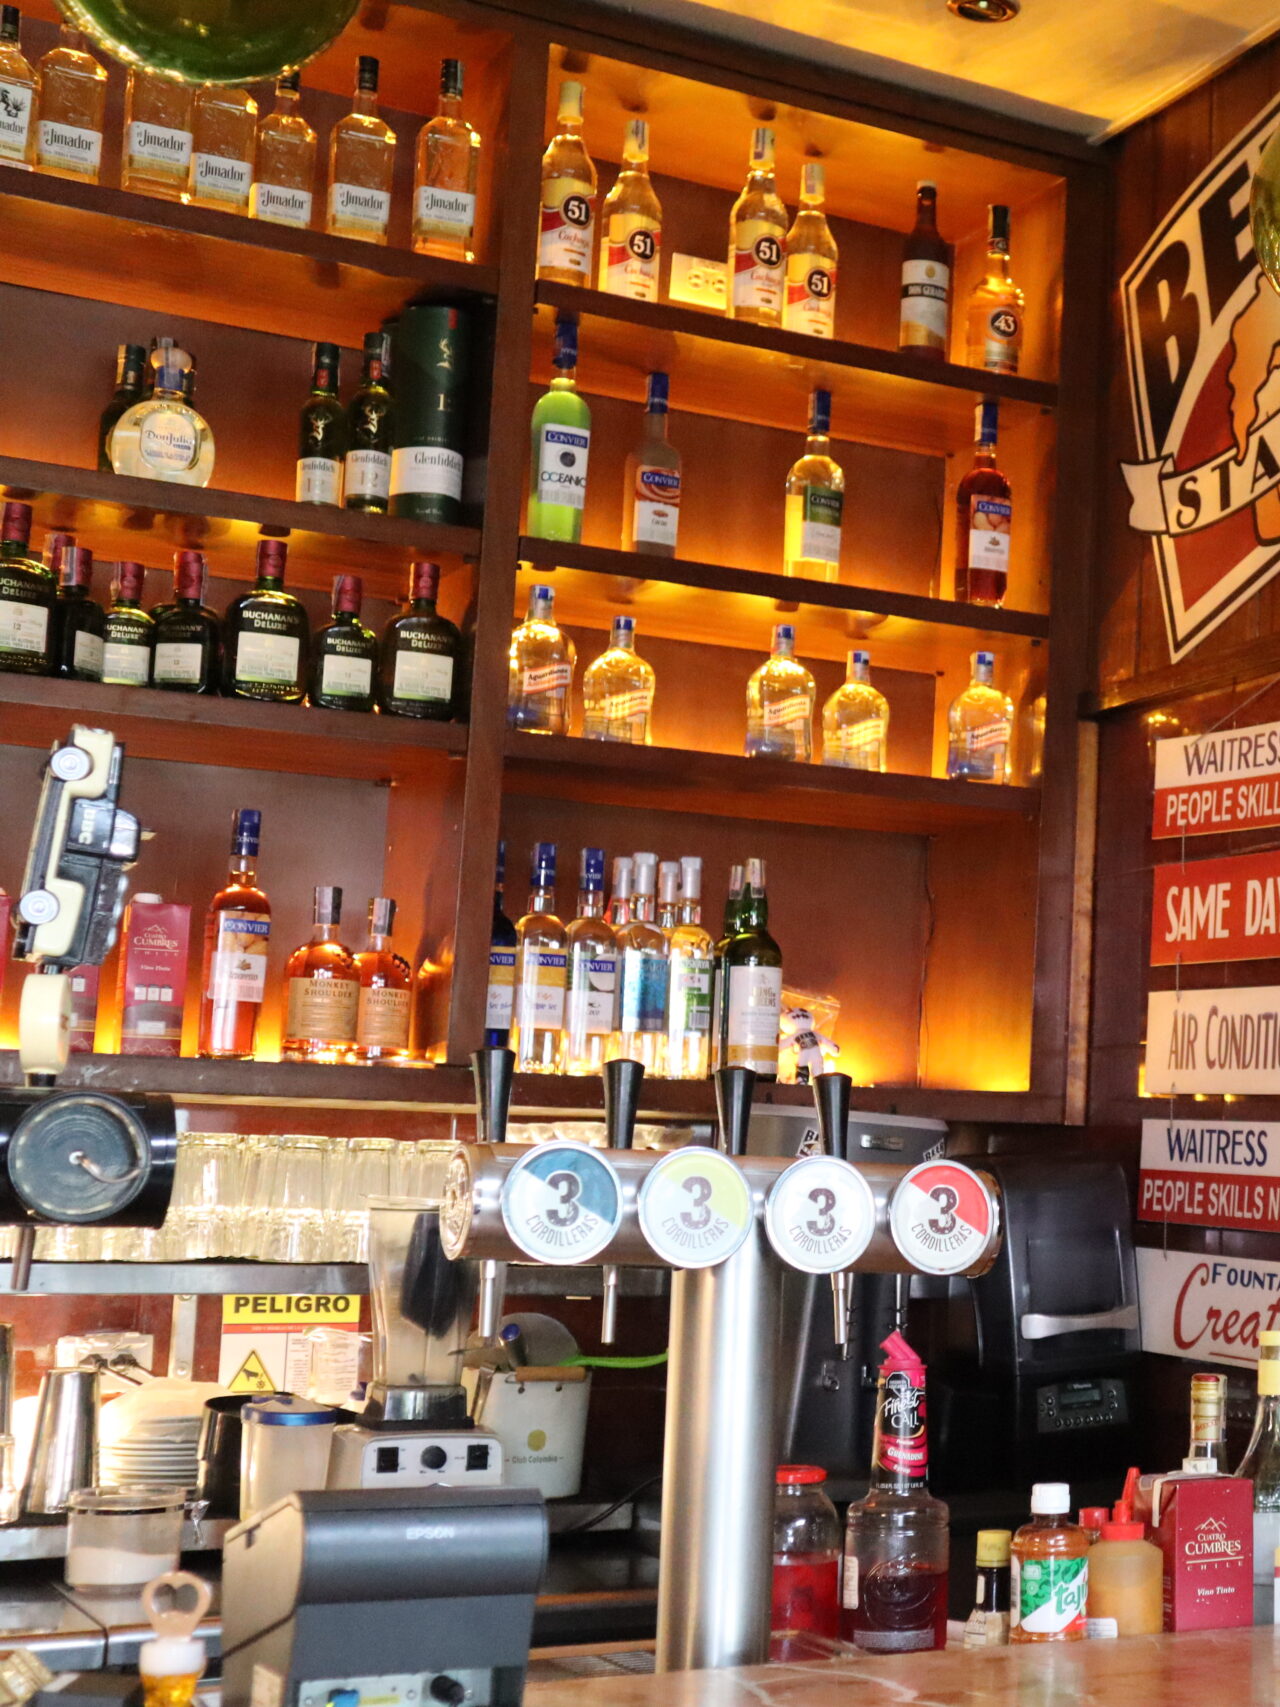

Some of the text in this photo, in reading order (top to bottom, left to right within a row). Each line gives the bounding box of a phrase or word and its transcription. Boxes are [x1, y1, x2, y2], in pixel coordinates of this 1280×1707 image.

[46, 128, 94, 152] Jimador
[139, 129, 187, 152] Jimador
[262, 190, 307, 210] Jimador
[341, 189, 384, 210] Jimador
[426, 193, 469, 213] Jimador
[567, 200, 587, 222] 51
[633, 236, 652, 256] 51
[758, 242, 778, 262] 51
[811, 274, 831, 295] 51
[994, 315, 1015, 332] 43
[547, 431, 587, 448] CONVIER
[643, 473, 680, 488] CONVIER
[1166, 788, 1234, 827] PEOPLE
[1165, 882, 1231, 942] SAME
[224, 920, 269, 934] CONVIER
[133, 936, 178, 949] CUMBRES
[490, 953, 514, 965] NVIER
[304, 988, 352, 998] SHOULDER
[310, 980, 349, 990] MONKEY
[1168, 1009, 1198, 1070] AIR
[1167, 1127, 1268, 1167] WAITRESS
[546, 1172, 580, 1227] 3
[680, 1176, 712, 1230] 3
[1142, 1178, 1205, 1215] PEOPLE
[1208, 1184, 1264, 1220] SKILLS
[806, 1187, 836, 1237] 3
[928, 1186, 958, 1235] 3
[525, 1213, 600, 1247] CORDILLERAS
[662, 1216, 729, 1249] CORDILLERAS
[789, 1225, 852, 1255] CORDILLERAS
[911, 1223, 973, 1253] CORDILLERAS
[234, 1296, 350, 1314] PELIGRO
[884, 1392, 925, 1417] Finest
[891, 1410, 919, 1429] CALL
[406, 1526, 455, 1540] EPSON
[1198, 1533, 1226, 1543] CUATRO
[1185, 1540, 1241, 1556] CUMBRES
[1187, 1560, 1243, 1571] CHILE
[1197, 1586, 1235, 1596] Vino Tinto
